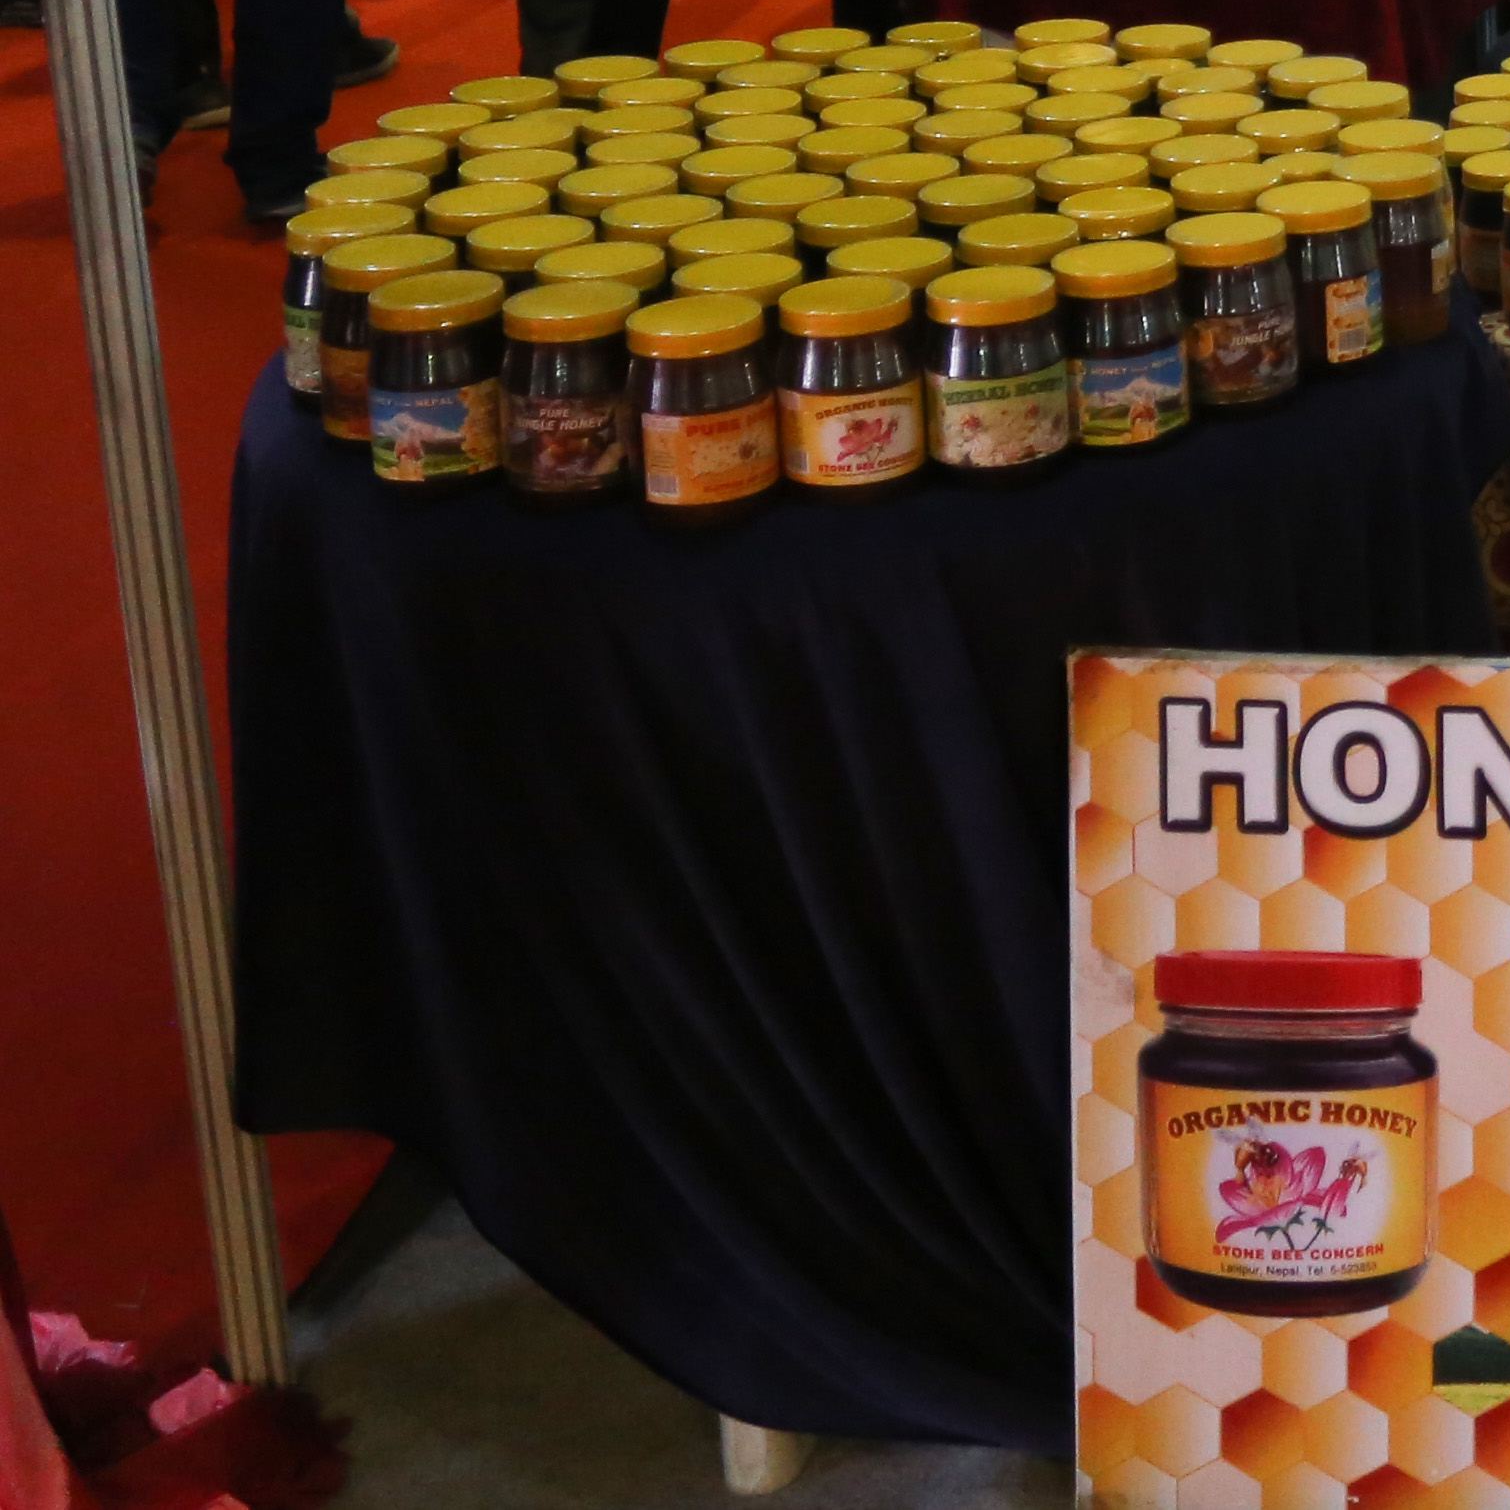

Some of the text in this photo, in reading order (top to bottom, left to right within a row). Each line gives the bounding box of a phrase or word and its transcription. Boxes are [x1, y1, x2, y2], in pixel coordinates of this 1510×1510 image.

[539, 408, 569, 417] PURE
[816, 400, 875, 421] ORGANIC
[685, 417, 741, 437] PURE
[1167, 1100, 1418, 1140] ORGANIC HONEY
[1212, 1243, 1384, 1260] STONE BEE CONCERN
